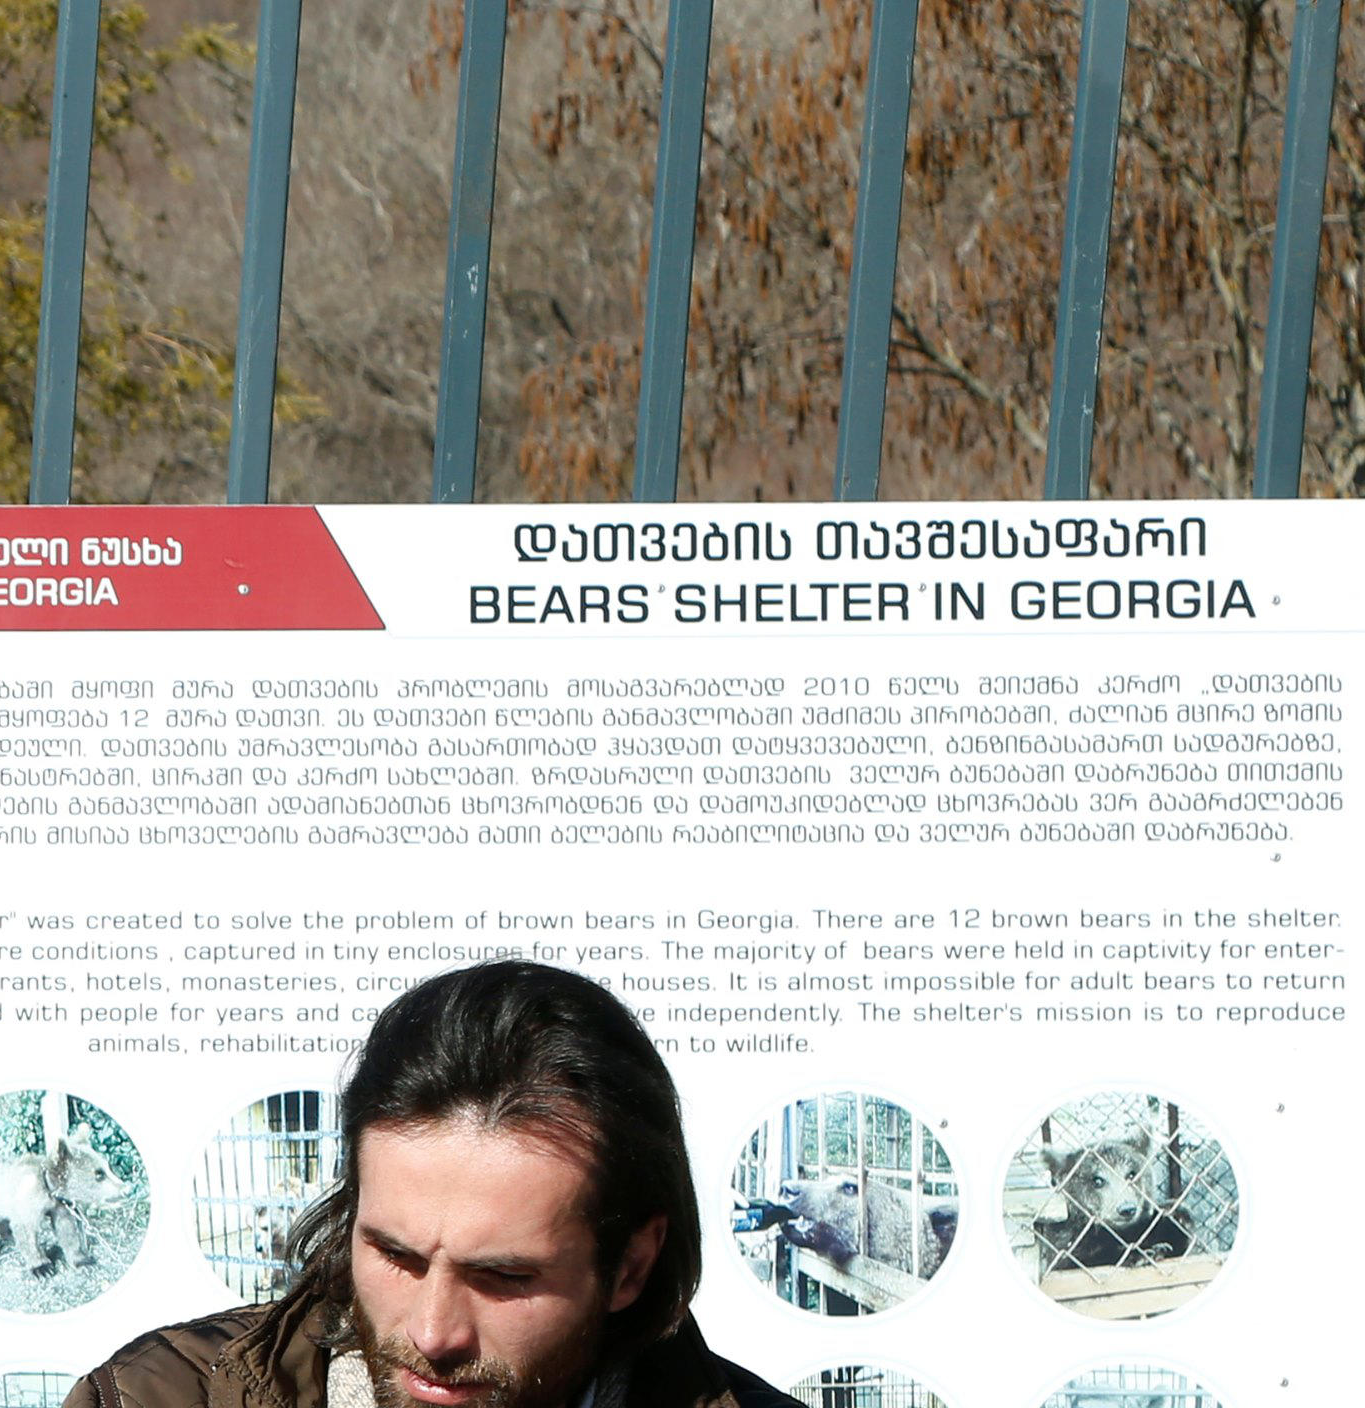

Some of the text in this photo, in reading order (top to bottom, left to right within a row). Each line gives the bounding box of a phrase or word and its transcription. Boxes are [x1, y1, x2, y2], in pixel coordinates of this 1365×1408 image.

[81, 537, 182, 566] ნუსხა
[513, 517, 1206, 563] დათვების თავშესაფარი
[470, 579, 1256, 624] BEARS SHELTER IN GEORGIA
[803, 676, 870, 697] 2010
[26, 914, 75, 930] was
[85, 910, 183, 930] created
[193, 912, 220, 930] to
[231, 910, 292, 930] solve
[303, 910, 344, 930] the
[355, 910, 454, 935] problem
[465, 909, 488, 930] of
[498, 909, 574, 930] brown
[585, 910, 655, 930] bears
[666, 910, 686, 929] in
[697, 908, 799, 934] Georgia.
[812, 908, 883, 929] There
[894, 913, 935, 929] are
[949, 908, 981, 929] 12
[991, 908, 1069, 929] brown
[1080, 908, 1151, 929] bears
[1162, 908, 1183, 928] in
[1193, 908, 1237, 929] the
[1247, 907, 1341, 929] shelter.
[31, 941, 159, 961] conditions
[184, 941, 296, 965] captured
[305, 941, 325, 961] in
[333, 941, 379, 966] tiny
[531, 940, 568, 961] for
[575, 945, 649, 966] years.
[660, 940, 704, 961] The
[713, 940, 817, 965] majority
[824, 939, 848, 961] of
[863, 940, 934, 961] bears
[943, 944, 1006, 961] were
[1014, 939, 1064, 960] held
[1073, 939, 1094, 960] in
[1102, 939, 1212, 965] captivity
[1219, 938, 1257, 960] for
[1264, 940, 1345, 960] enter-
[86, 971, 170, 993] hotels,
[181, 972, 345, 993] monasteries,
[622, 971, 717, 992] houses.
[729, 971, 748, 992] It
[758, 972, 778, 992] is
[787, 971, 874, 992] almost
[883, 970, 1016, 996] impossible
[1024, 970, 1061, 991] for
[1070, 970, 1134, 993] adult
[1144, 970, 1216, 991] bears
[1225, 972, 1253, 991] to
[1263, 972, 1346, 991] return
[14, 1002, 68, 1022] with
[80, 1002, 158, 1027] people
[169, 1001, 205, 1023] for
[216, 1007, 284, 1027] years
[296, 1002, 339, 1023] and
[667, 1002, 843, 1027] independently.
[856, 1001, 901, 1023] The
[1036, 1001, 1132, 1022] mission
[1144, 1001, 1164, 1022] is
[1176, 1003, 1204, 1022] to
[1216, 1001, 1346, 1026] reproduce
[87, 1033, 188, 1055] animals,
[689, 1035, 716, 1054] to
[725, 1032, 814, 1054] wildlife.
